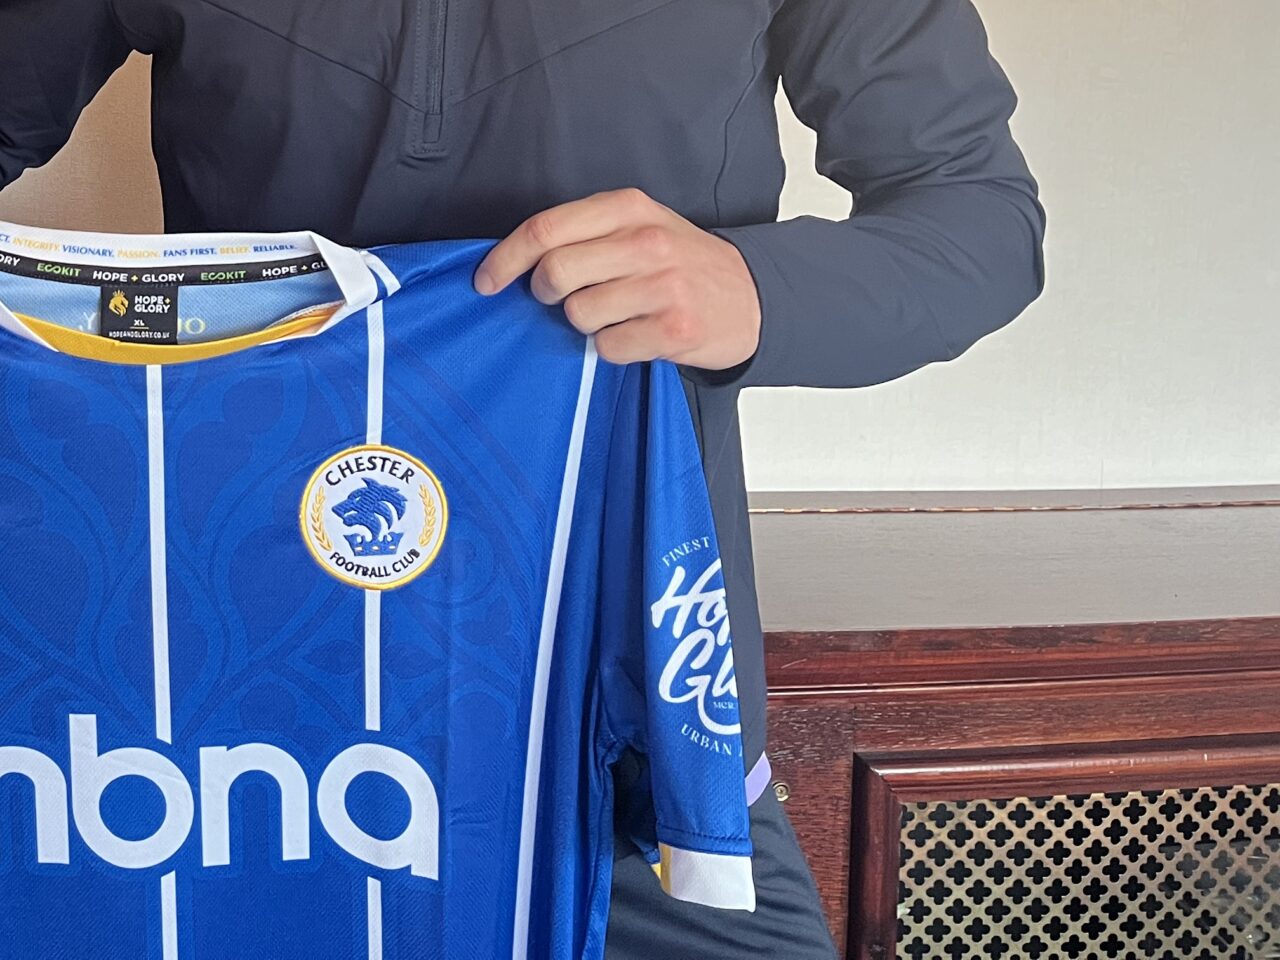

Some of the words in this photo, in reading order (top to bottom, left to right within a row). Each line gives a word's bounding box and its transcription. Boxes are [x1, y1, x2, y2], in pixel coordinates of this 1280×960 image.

[163, 248, 188, 258] FANS
[92, 270, 129, 283] HOPE
[141, 272, 186, 283] GLORY
[262, 265, 298, 278] HOPE
[134, 303, 171, 314] GLORY
[133, 319, 145, 327] XL
[325, 455, 415, 486] CHESTER
[329, 551, 391, 578] FOOTBALL
[392, 547, 421, 573] CLUB
[661, 535, 710, 567] FINEST
[681, 723, 732, 756] URBAN
